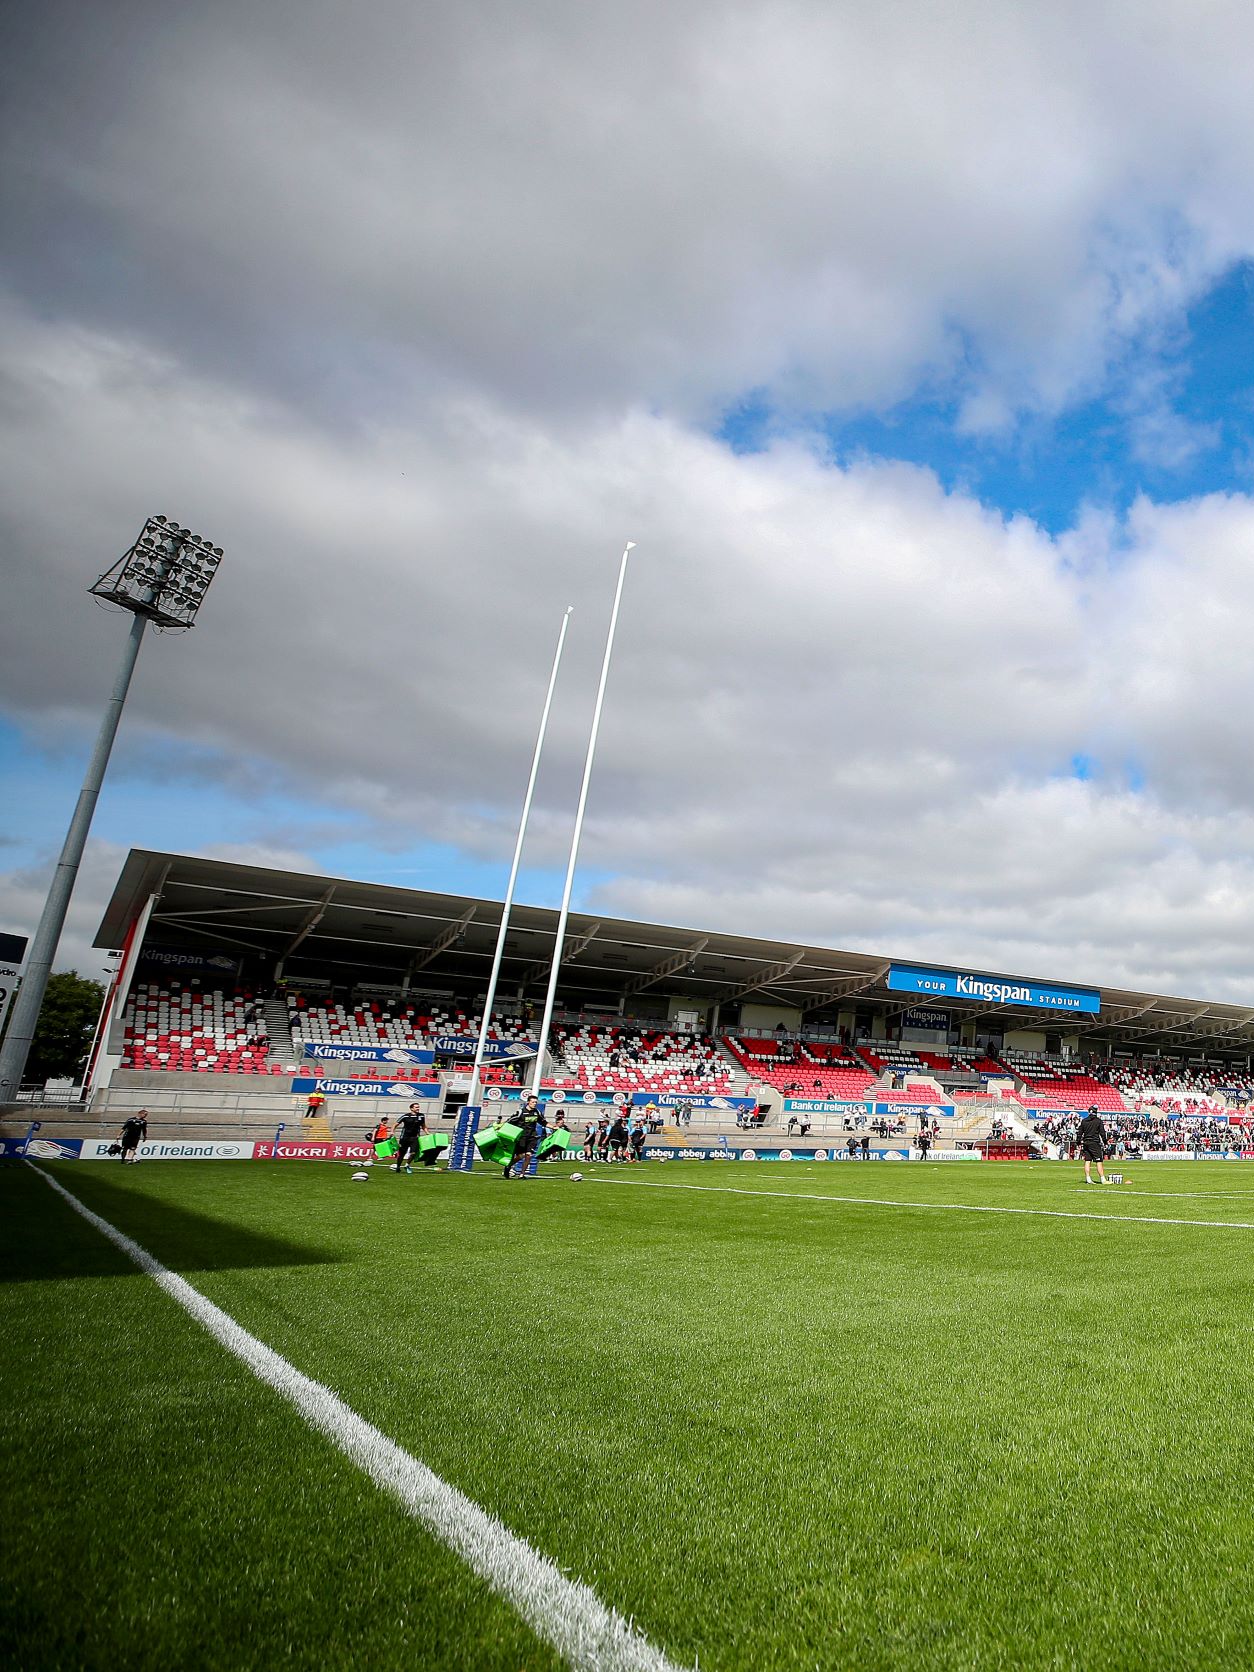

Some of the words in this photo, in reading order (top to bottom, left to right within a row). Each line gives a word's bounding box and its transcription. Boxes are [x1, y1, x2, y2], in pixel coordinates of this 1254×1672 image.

[141, 950, 203, 965] Kingspan
[917, 980, 946, 991] YOUR
[1039, 995, 1081, 1007] STADIUM
[907, 1008, 947, 1023] Kingspan
[314, 1046, 378, 1061] Kingspan
[315, 1080, 383, 1095] Kingspan
[791, 1101, 813, 1110] Bank
[814, 1102, 824, 1111] of
[824, 1103, 853, 1112] Ireland
[141, 1145, 160, 1155] of
[160, 1145, 214, 1156] Ireland
[271, 1146, 326, 1157] KUKRI
[646, 1148, 675, 1159] abbey
[678, 1149, 706, 1159] abbey
[933, 1152, 941, 1160] of
